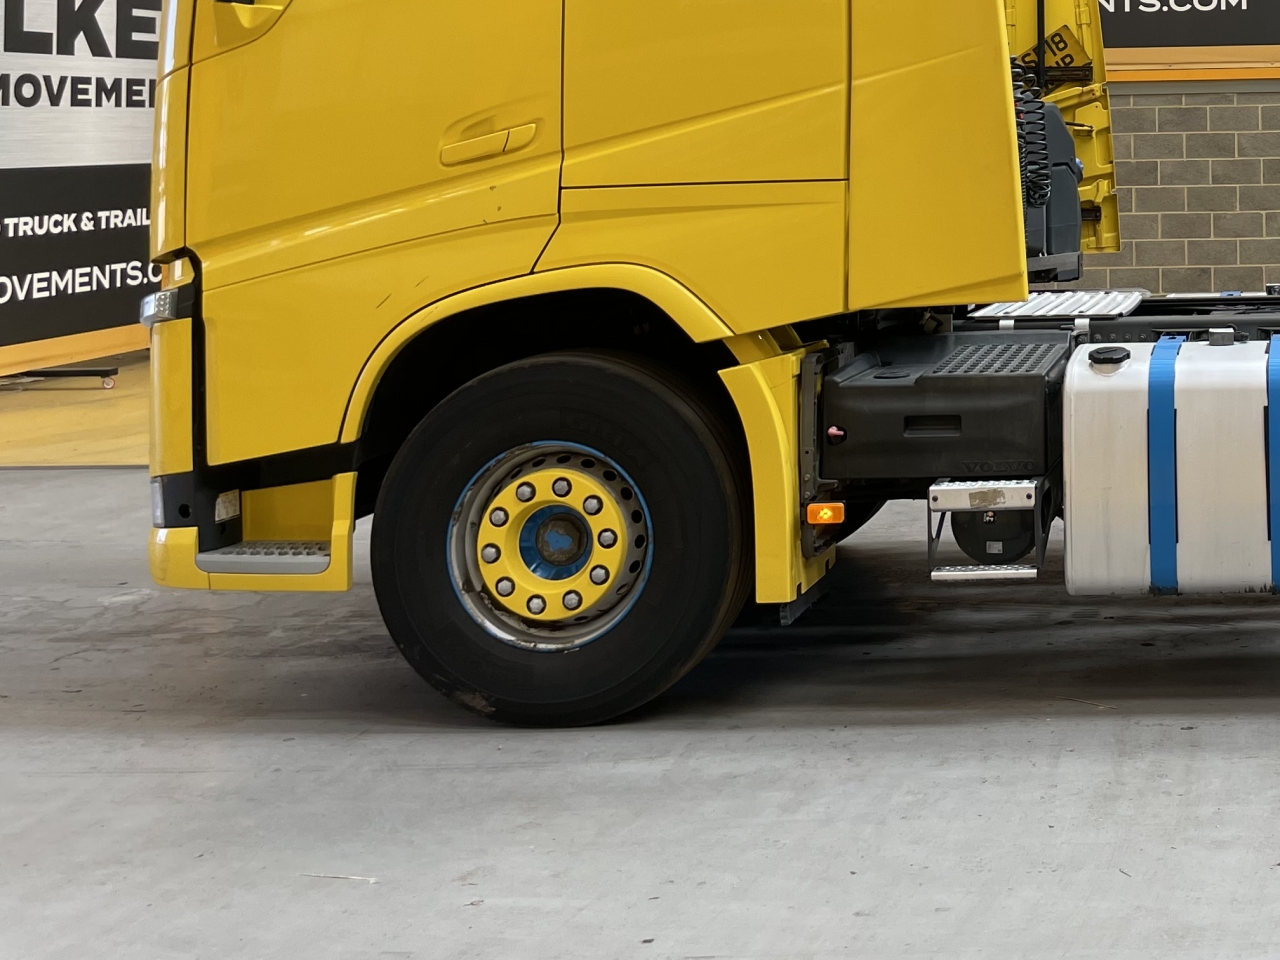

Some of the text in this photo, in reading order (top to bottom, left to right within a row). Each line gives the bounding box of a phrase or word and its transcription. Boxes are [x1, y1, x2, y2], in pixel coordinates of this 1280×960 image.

[0, 73, 156, 108] OVEME
[4, 208, 151, 237] TRUCK & TRAIL
[961, 460, 1036, 473] VOLVO
